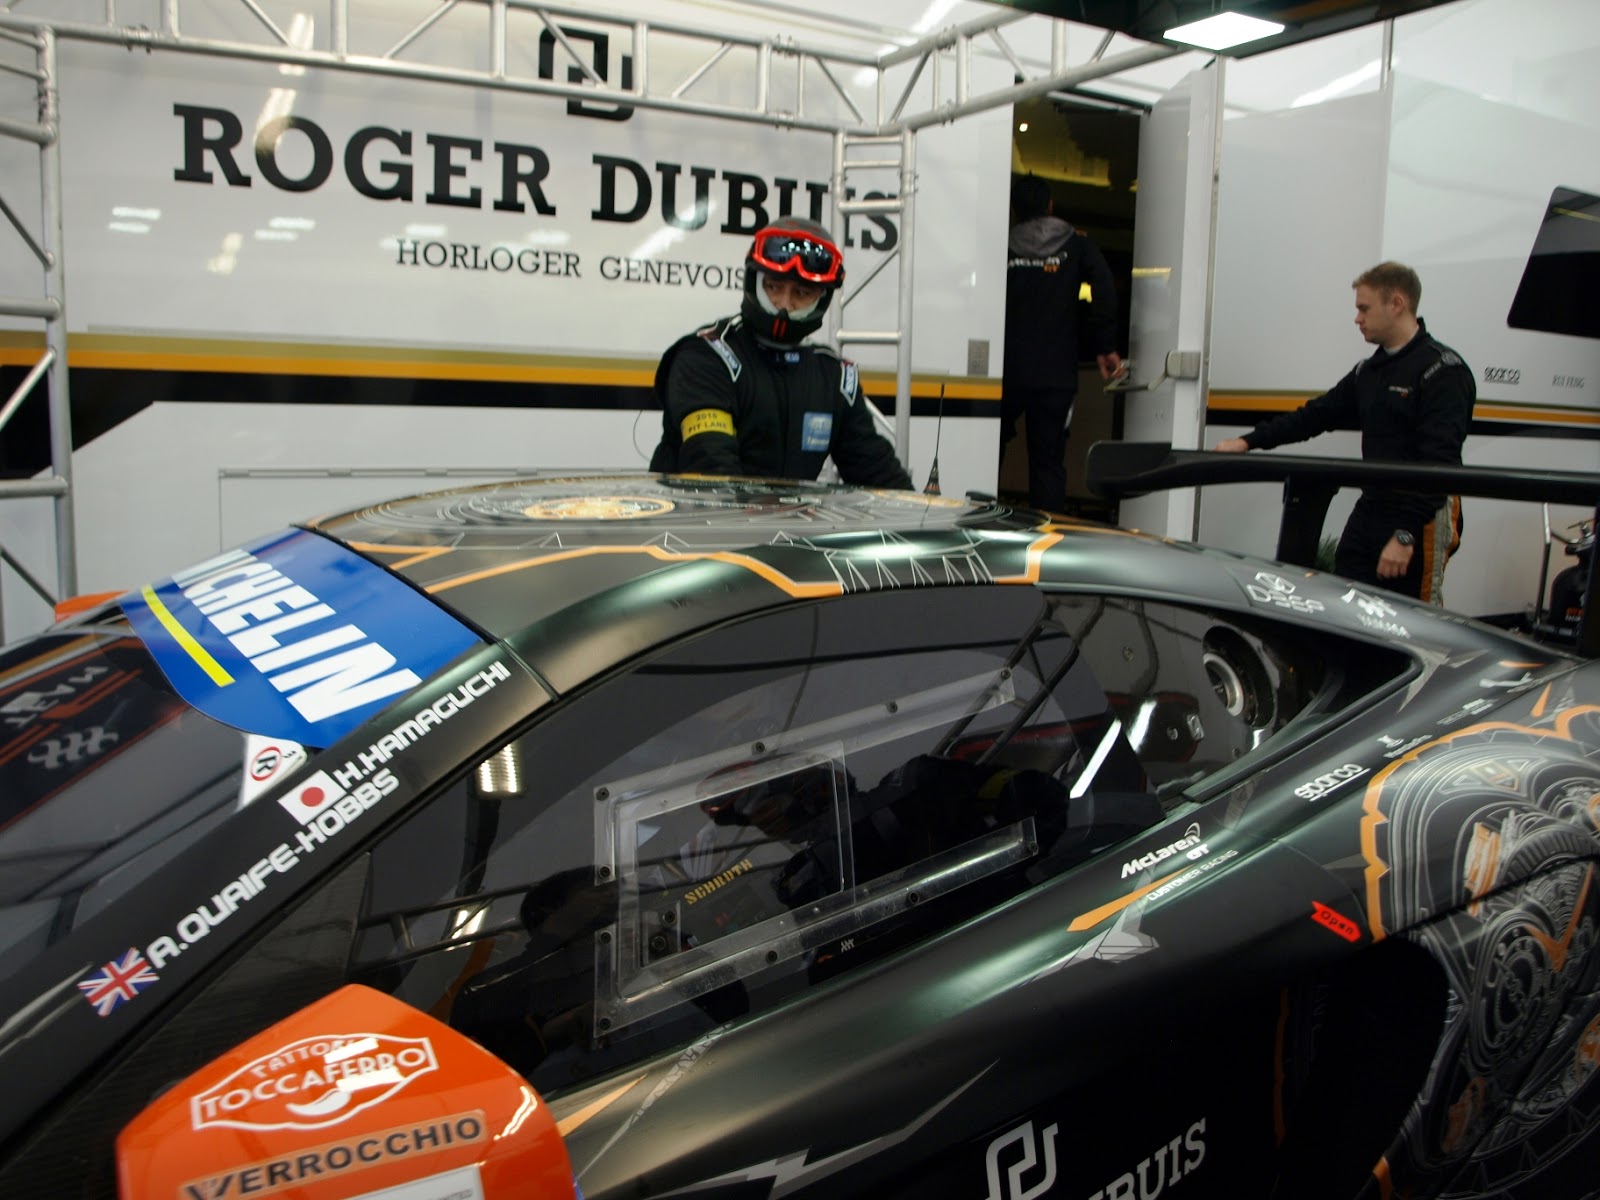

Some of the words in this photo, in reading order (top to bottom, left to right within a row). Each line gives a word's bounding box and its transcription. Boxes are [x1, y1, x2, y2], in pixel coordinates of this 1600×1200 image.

[173, 103, 556, 216] ROGER
[396, 238, 581, 278] HORLOGER
[599, 256, 744, 291] GENEVOIS
[333, 660, 512, 789] H.HAMAGUCHI
[1294, 763, 1370, 801] sparco
[146, 767, 400, 969] A.QUAIFE-HOBBS
[1121, 833, 1201, 879] McLaren
[1147, 866, 1202, 902] CUSTOMER
[1202, 849, 1239, 873] RACING
[1185, 843, 1210, 861] GT
[684, 858, 753, 905] SCHROTH
[1320, 910, 1355, 936] Open
[185, 1117, 480, 1200] VERROCCHIO
